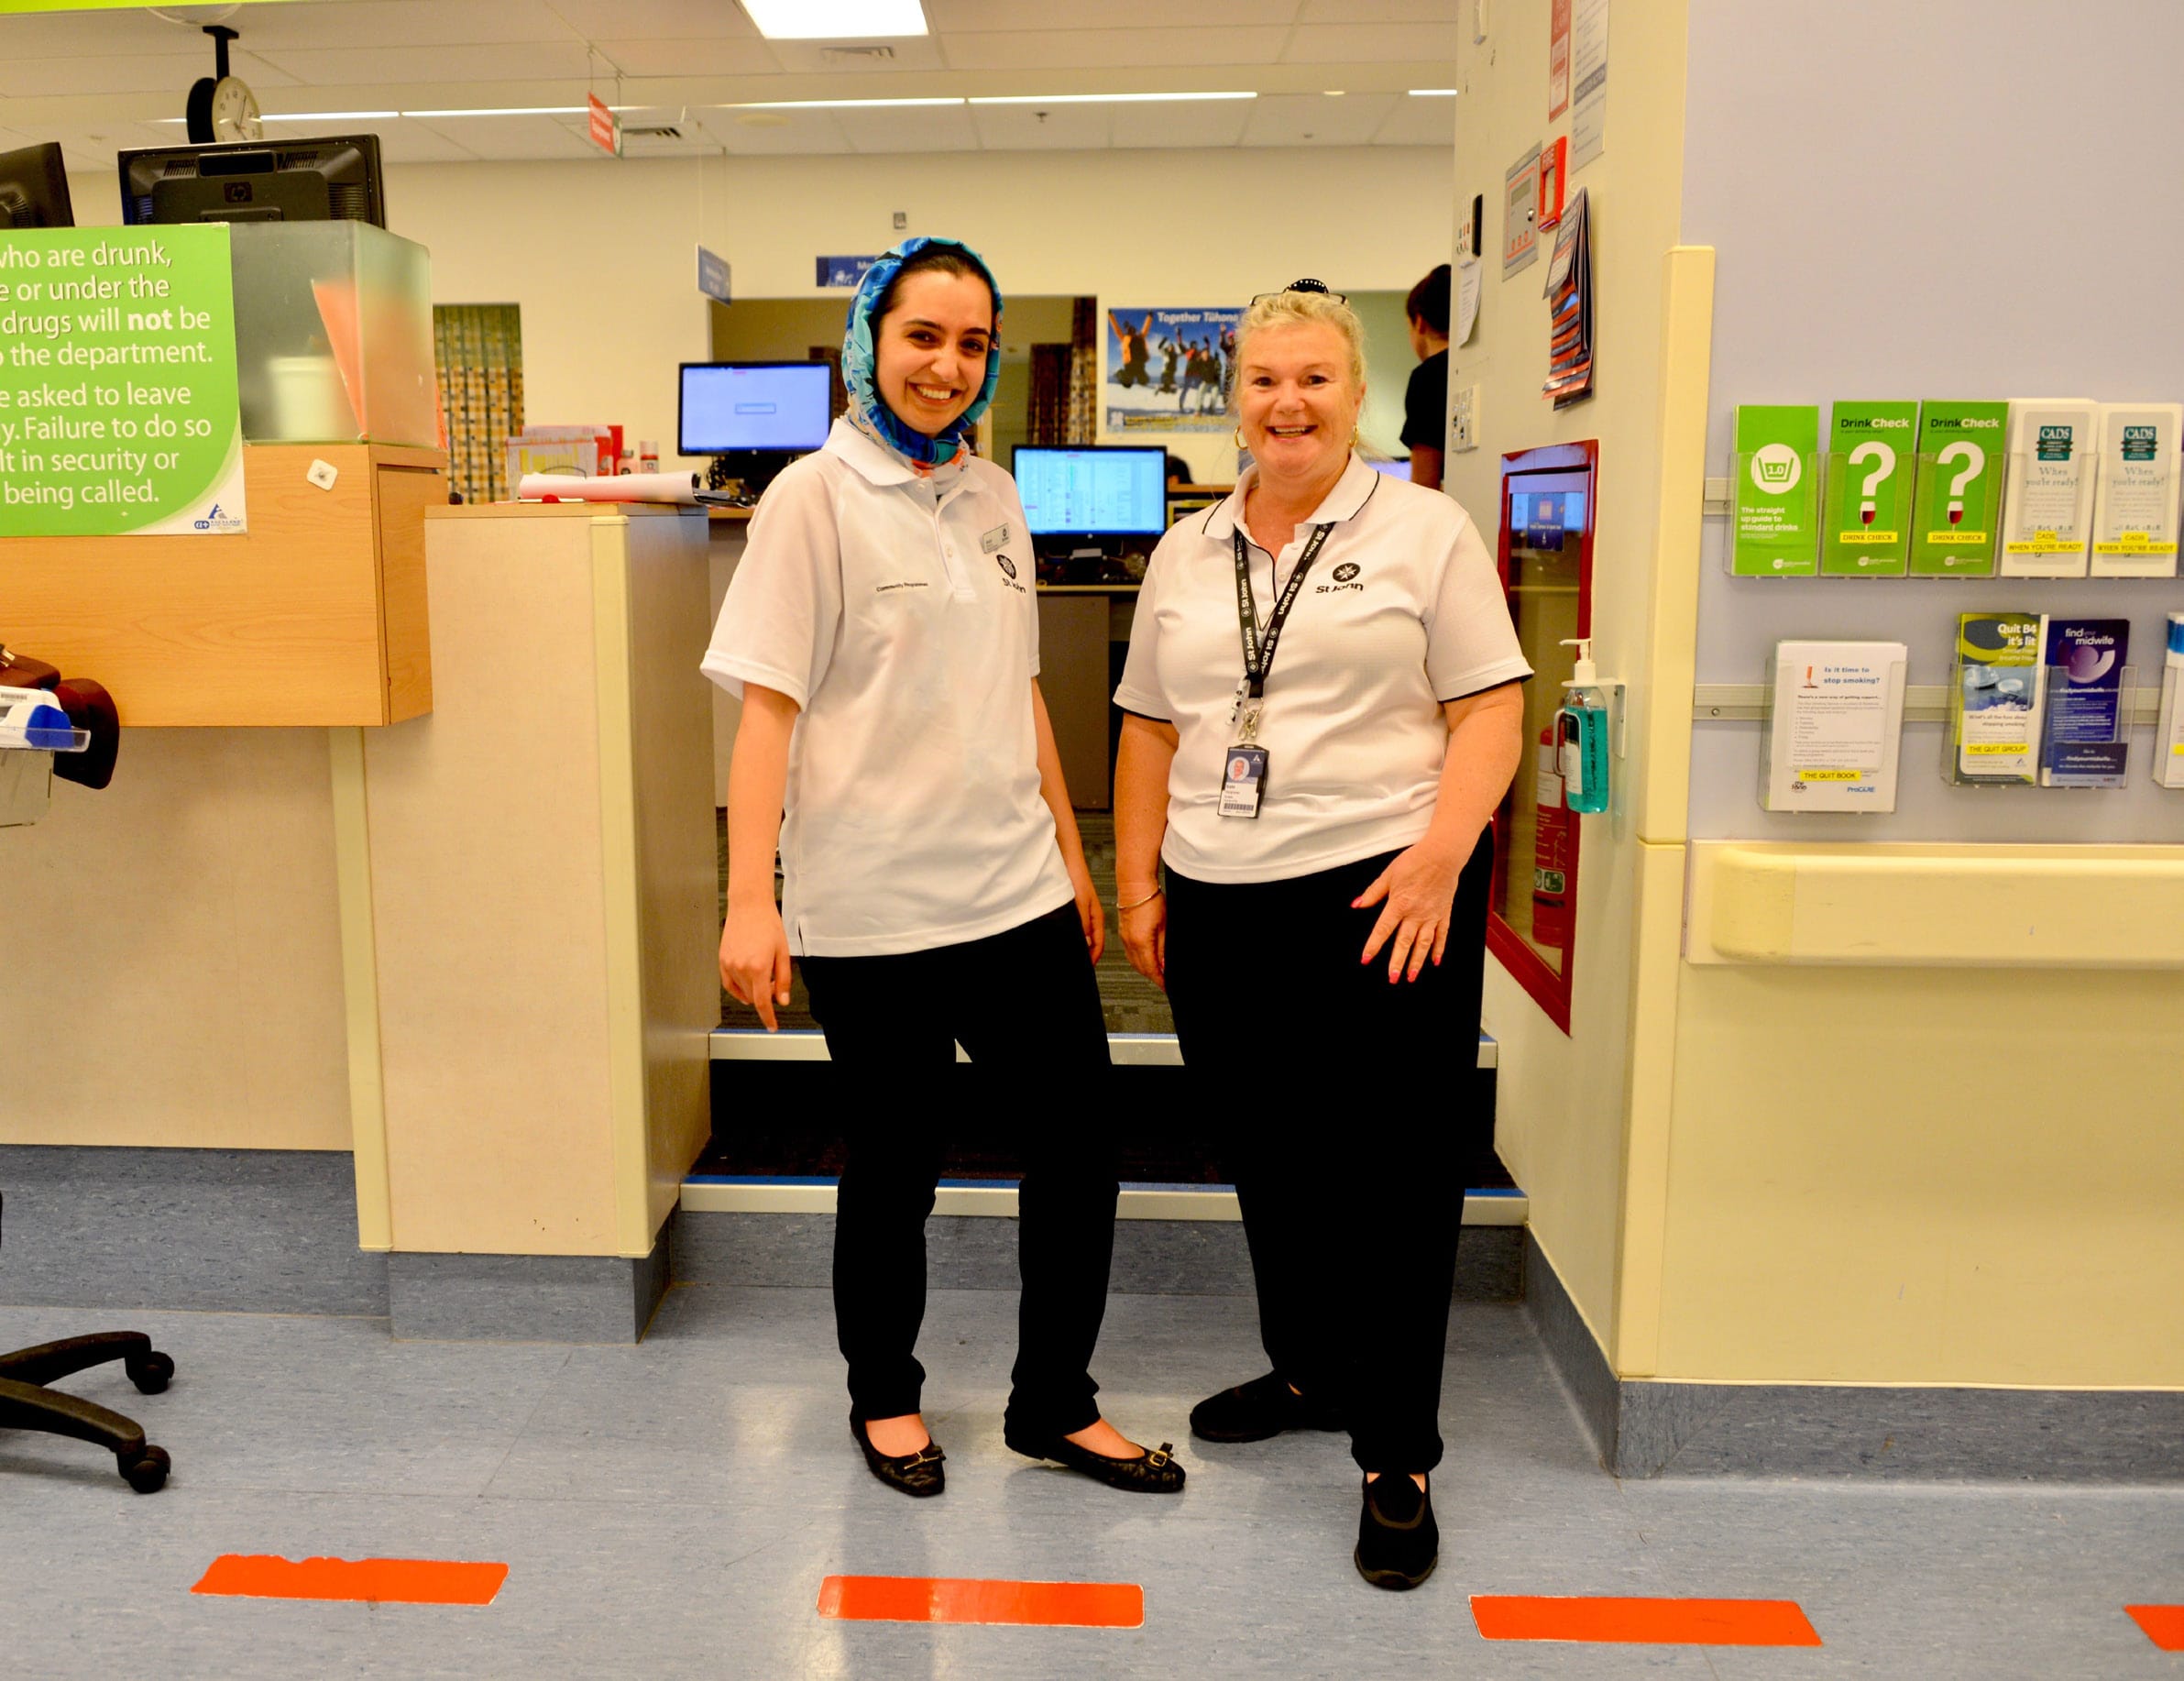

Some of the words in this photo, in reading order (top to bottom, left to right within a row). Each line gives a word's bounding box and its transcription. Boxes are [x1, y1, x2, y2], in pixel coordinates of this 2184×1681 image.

[48, 247, 84, 268] are
[93, 240, 172, 268] drunk,
[16, 284, 41, 302] or
[49, 275, 121, 301] under
[128, 274, 170, 299] the
[3, 311, 72, 339] drugs
[78, 308, 120, 332] will
[127, 308, 173, 331] not
[181, 306, 211, 330] be
[1158, 312, 1202, 325] Together
[10, 343, 50, 367] the
[58, 341, 213, 370] department.
[17, 382, 87, 408] asked
[94, 386, 119, 406] to
[127, 381, 191, 405] leave
[25, 416, 104, 440] Failure
[112, 419, 137, 439] to
[144, 413, 177, 438] do
[184, 418, 212, 437] so
[2041, 428, 2070, 439] CADS
[2124, 428, 2154, 439] CADS
[22, 450, 43, 471] in
[51, 447, 147, 477] security
[154, 451, 180, 470] or
[1768, 465, 1784, 475] 1.0
[5, 481, 74, 511] being
[81, 478, 159, 504] called.
[1756, 507, 1785, 515] straight
[1289, 581, 1299, 593] St
[1316, 585, 1328, 594] St
[1331, 582, 1364, 593] John
[1242, 597, 1249, 608] St
[1278, 592, 1293, 615] John
[1997, 623, 2022, 634] Quit
[2023, 623, 2037, 633] B4
[2065, 628, 2085, 638] find
[1246, 627, 1255, 649] John
[2007, 635, 2024, 645] it's
[2025, 636, 2036, 645] lit
[2075, 636, 2114, 645] midwife
[1267, 640, 1274, 651] St
[1247, 650, 1256, 661] St
